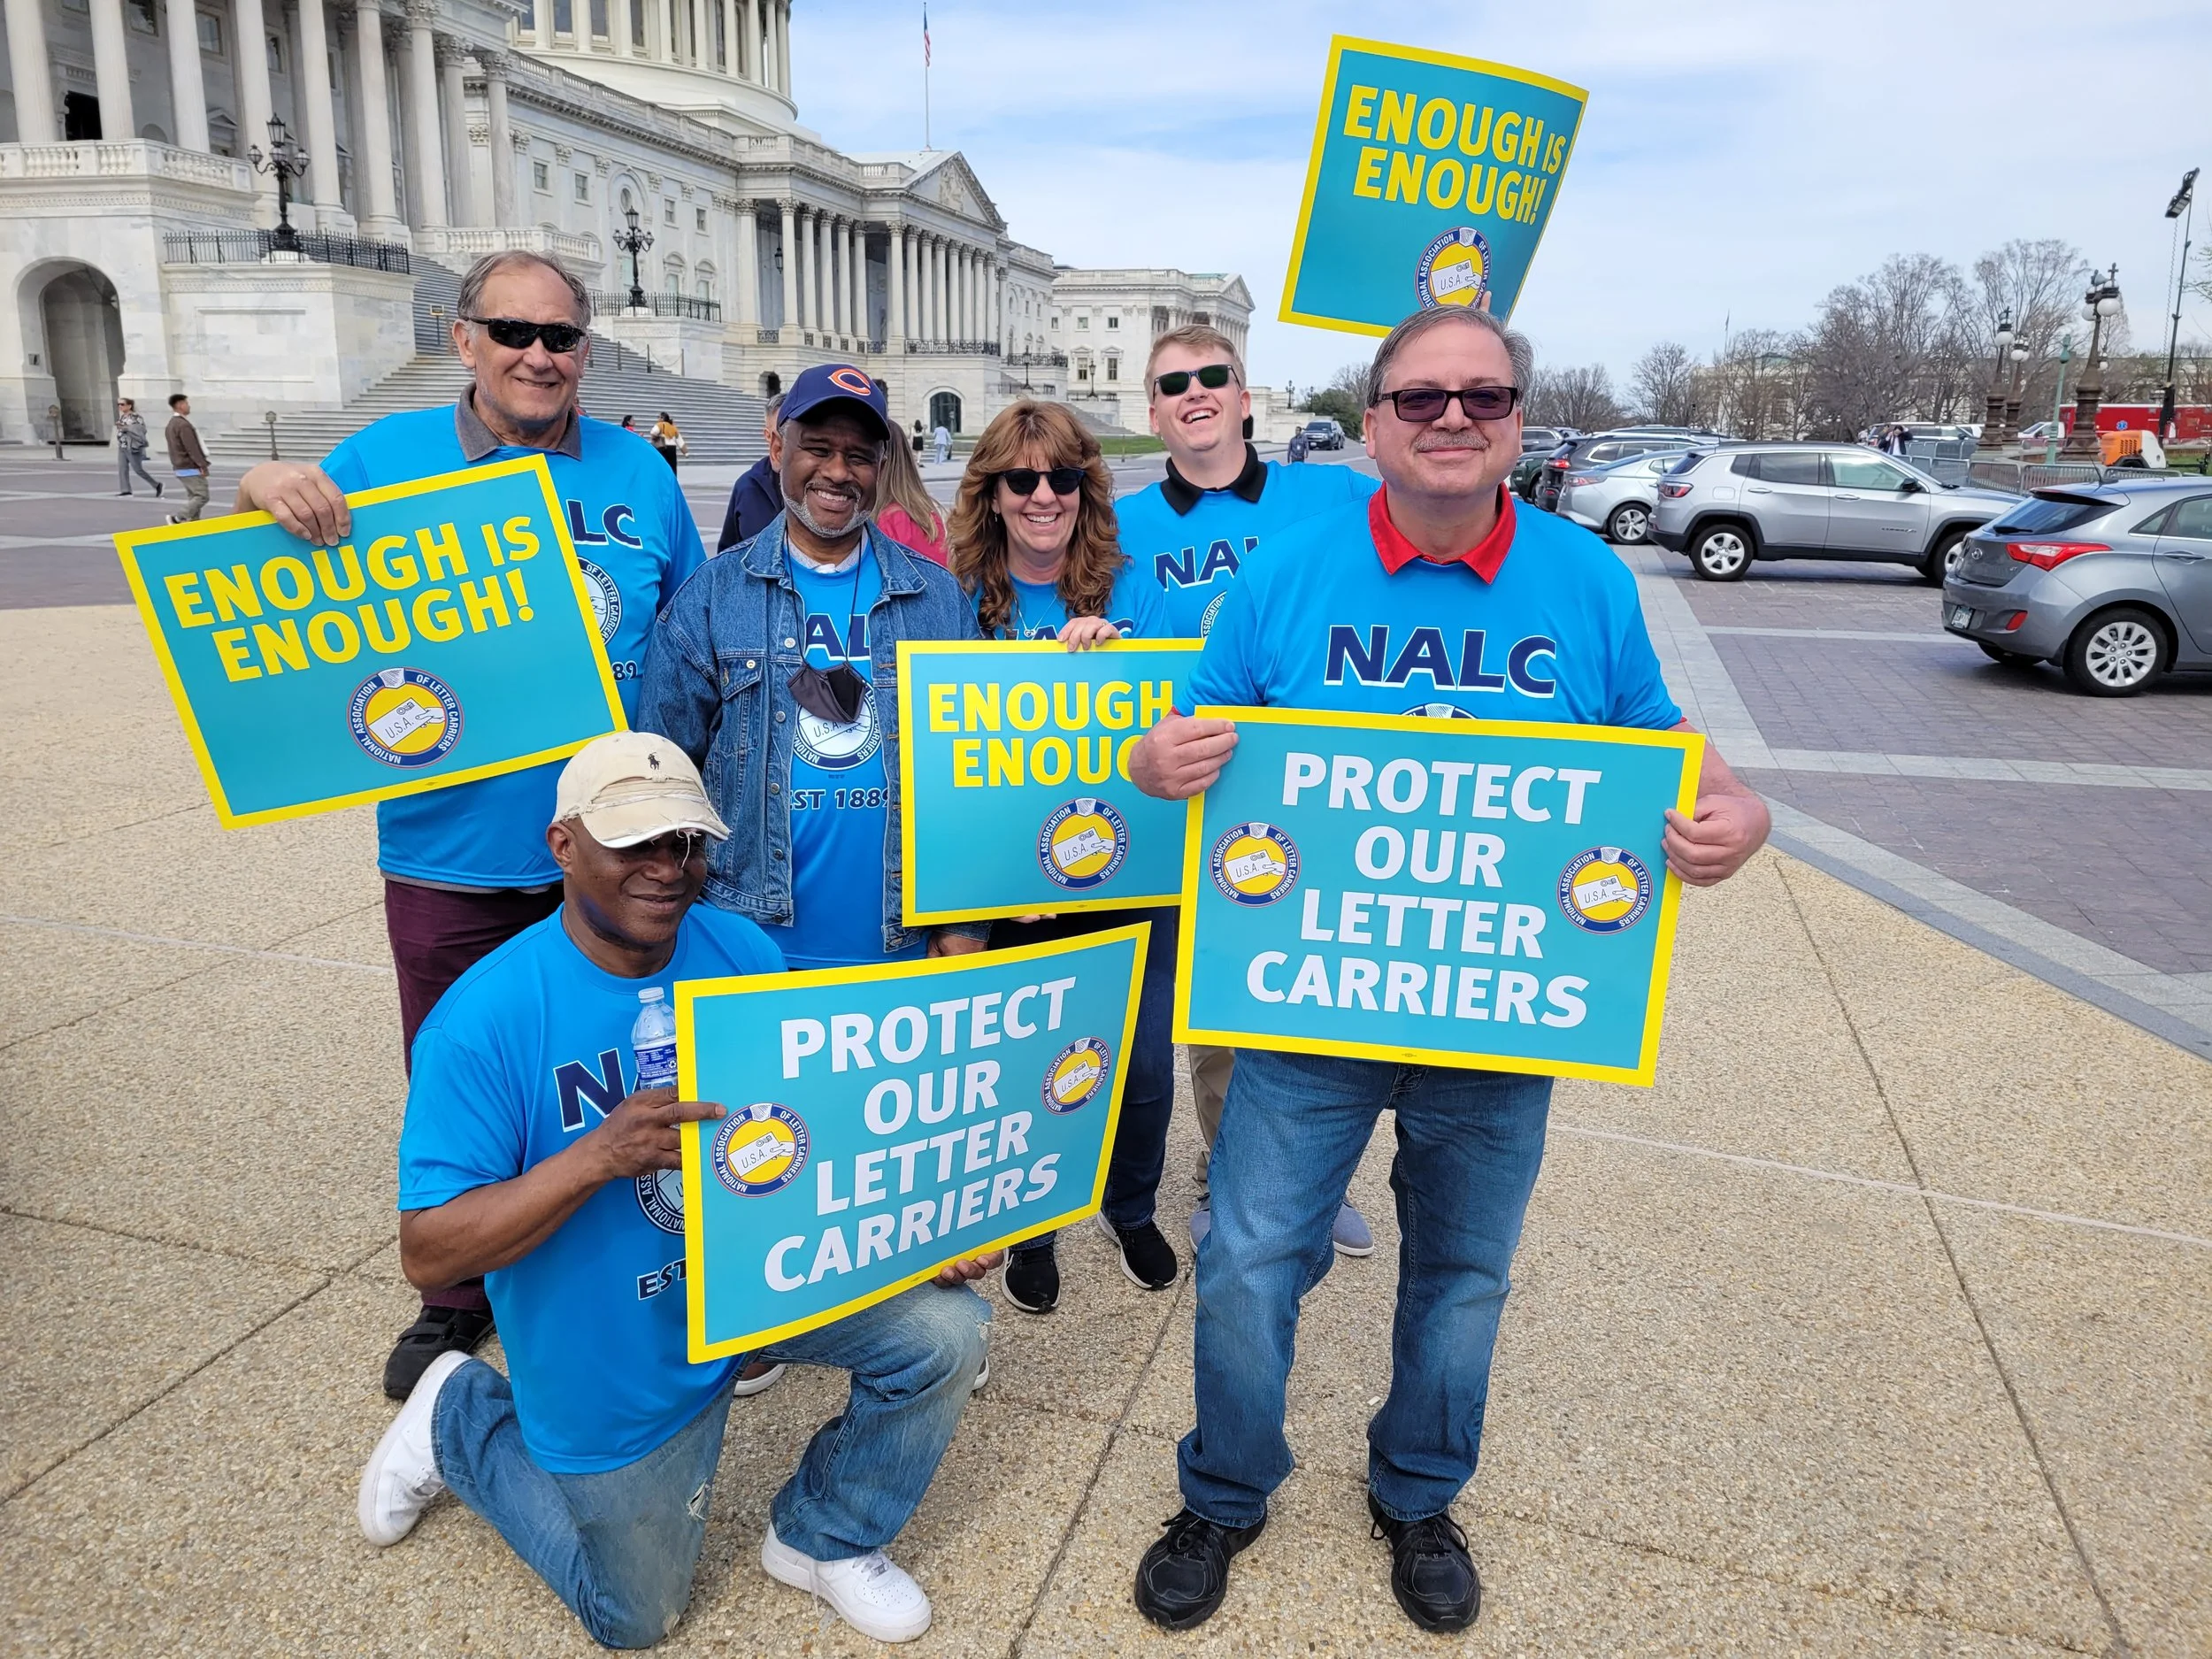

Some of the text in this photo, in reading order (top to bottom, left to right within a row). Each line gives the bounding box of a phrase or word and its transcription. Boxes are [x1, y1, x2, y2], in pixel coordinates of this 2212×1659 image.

[1343, 84, 1566, 174] ENOUGH IS
[1353, 145, 1547, 226] ENOUGH!
[1419, 234, 1454, 277] ASSOCIATION
[1479, 241, 1486, 250] OF
[1419, 280, 1436, 307] TIONAL
[1440, 274, 1463, 290] U.S.A.
[163, 515, 541, 629] ENOUGH IS
[587, 564, 597, 575] OF
[598, 573, 617, 603] LETTER
[1155, 537, 1258, 592] NA
[211, 568, 534, 682] ENOUGH!
[1323, 625, 1556, 698] NALC
[352, 674, 458, 764] NATIONAL ASSOCIATION OF LETTER CARRIERS
[385, 717, 414, 739] U.S.A.
[928, 680, 1173, 733] ENOUGH
[794, 734, 820, 764] NATION
[1281, 751, 1602, 825] PROTECT
[1041, 807, 1125, 885] NATIONAL ASSOCIATION OF LETTER CARRIERS
[1064, 843, 1088, 861] U.S.A.
[1213, 828, 1296, 899] NATIONAL ASSOCIATION OF LETTER CARRIERS
[1235, 864, 1259, 878] U.S.A.
[1354, 825, 1505, 888] OUR
[1562, 852, 1648, 927] NATIONAL ASSOCIATION OF LETTER CARRIERS
[1584, 889, 1609, 903] U.S.A.
[1299, 887, 1547, 959] LETTER
[1246, 949, 1590, 1028] CARRIERS
[780, 976, 1078, 1079] PROTECT
[1045, 1048, 1071, 1090] ASSOCIATION
[1099, 1047, 1109, 1068] LETTER
[780, 1110, 791, 1120] OF
[863, 1059, 1001, 1135] OUR
[716, 1113, 746, 1162] ASSOCIATION
[789, 1118, 806, 1145] LETTER
[718, 1164, 748, 1192] NATIONAL
[741, 1149, 767, 1169] U.S.A.
[780, 1147, 806, 1183] CARRIERS
[816, 1110, 1033, 1217] LETTER
[764, 1153, 1062, 1293] CARRIERS
